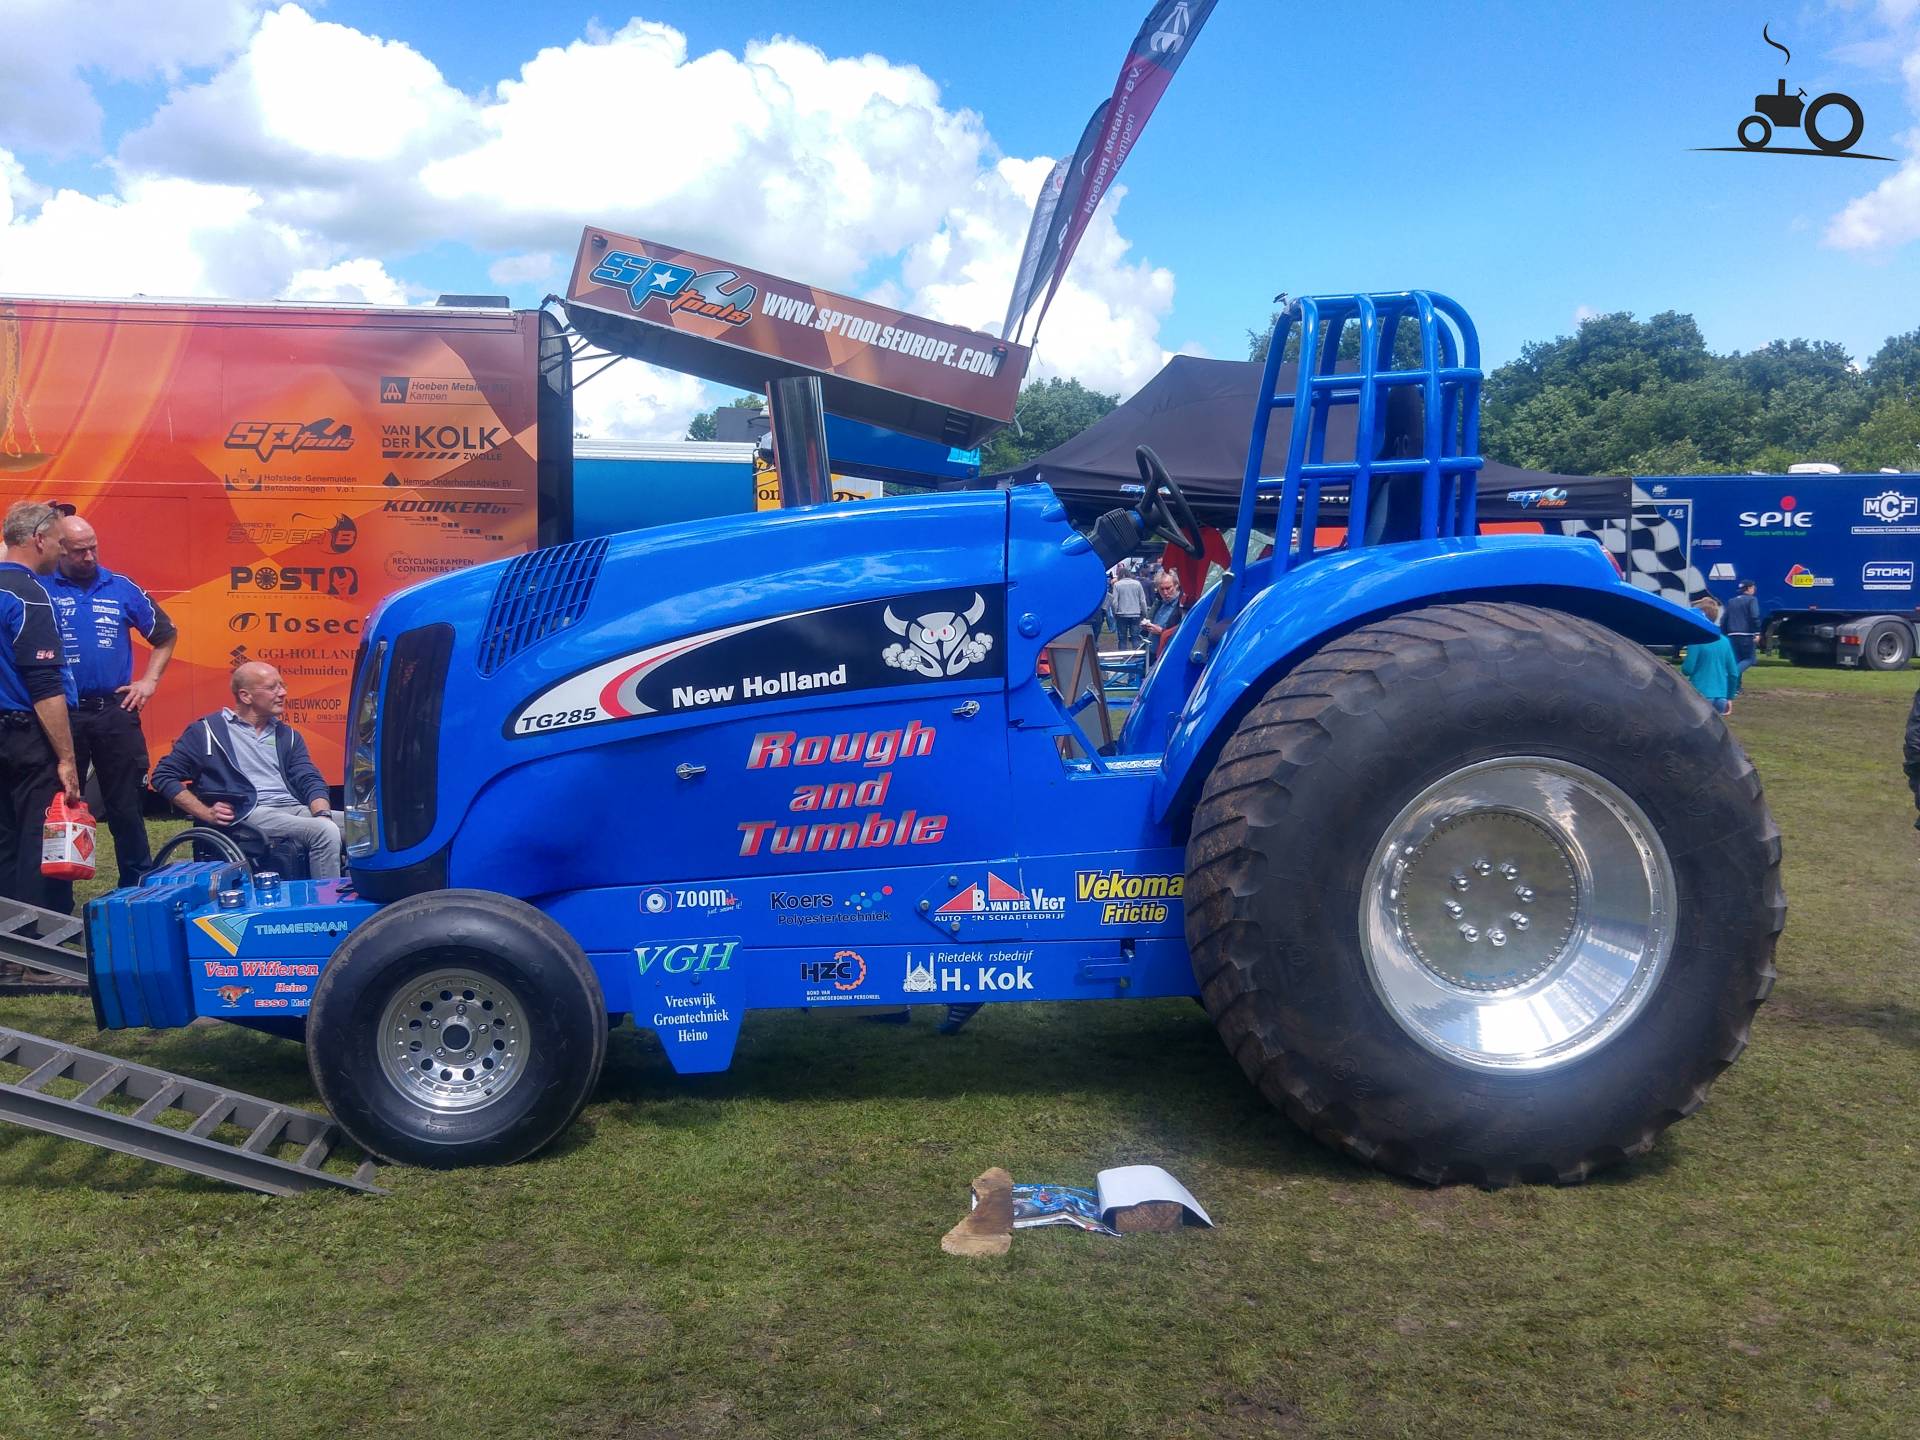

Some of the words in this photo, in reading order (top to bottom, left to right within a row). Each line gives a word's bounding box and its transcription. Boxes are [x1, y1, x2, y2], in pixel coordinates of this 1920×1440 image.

[1112, 113, 1135, 172] Kampen
[1084, 157, 1111, 213] Hoeben
[1105, 96, 1129, 154] Metalen
[761, 291, 1001, 378] WWW.SPTOOLSEUROPE.COM
[411, 381, 449, 391] Hoeben
[452, 382, 488, 392] Metal
[409, 392, 447, 401] Kampen
[382, 425, 410, 435] VAN
[415, 425, 501, 449] KOLK
[382, 438, 410, 448] DER
[463, 452, 502, 461] ZWOLLE
[264, 473, 302, 482] Hofstede
[1865, 495, 1915, 519] MCF
[1739, 511, 1813, 528] SPIE
[392, 557, 439, 565] RECYCLING
[441, 558, 474, 566] KAMPEN
[231, 567, 325, 591] POST
[265, 612, 359, 634] Tosec
[672, 681, 735, 709] New
[743, 664, 847, 699] Holland
[285, 699, 341, 711] NIEUWKOOP
[522, 706, 597, 732] TG285
[746, 719, 937, 770] Rough
[789, 772, 893, 812] and
[738, 809, 948, 857] Tumble
[1077, 872, 1184, 900] Vekoma
[769, 891, 833, 911] Koers
[972, 889, 990, 912] B.
[990, 901, 1010, 911] VAN
[1012, 900, 1031, 911] DER
[778, 910, 891, 926] Polyestertechniek
[988, 913, 1065, 921] SCHADEBEDRIJF
[1103, 904, 1167, 923] Frictie
[254, 920, 348, 936] TIMMERMAN
[634, 940, 741, 976] VGH
[204, 961, 238, 978] Van
[241, 960, 319, 977] Wifferen
[275, 982, 308, 993] Heino
[941, 968, 971, 992] H.
[978, 965, 1035, 991] Kok
[255, 999, 288, 1008] ESSO
[665, 993, 717, 1008] Vreeswijk
[653, 1008, 729, 1026] Groentechniek
[678, 1029, 708, 1042] Heino
